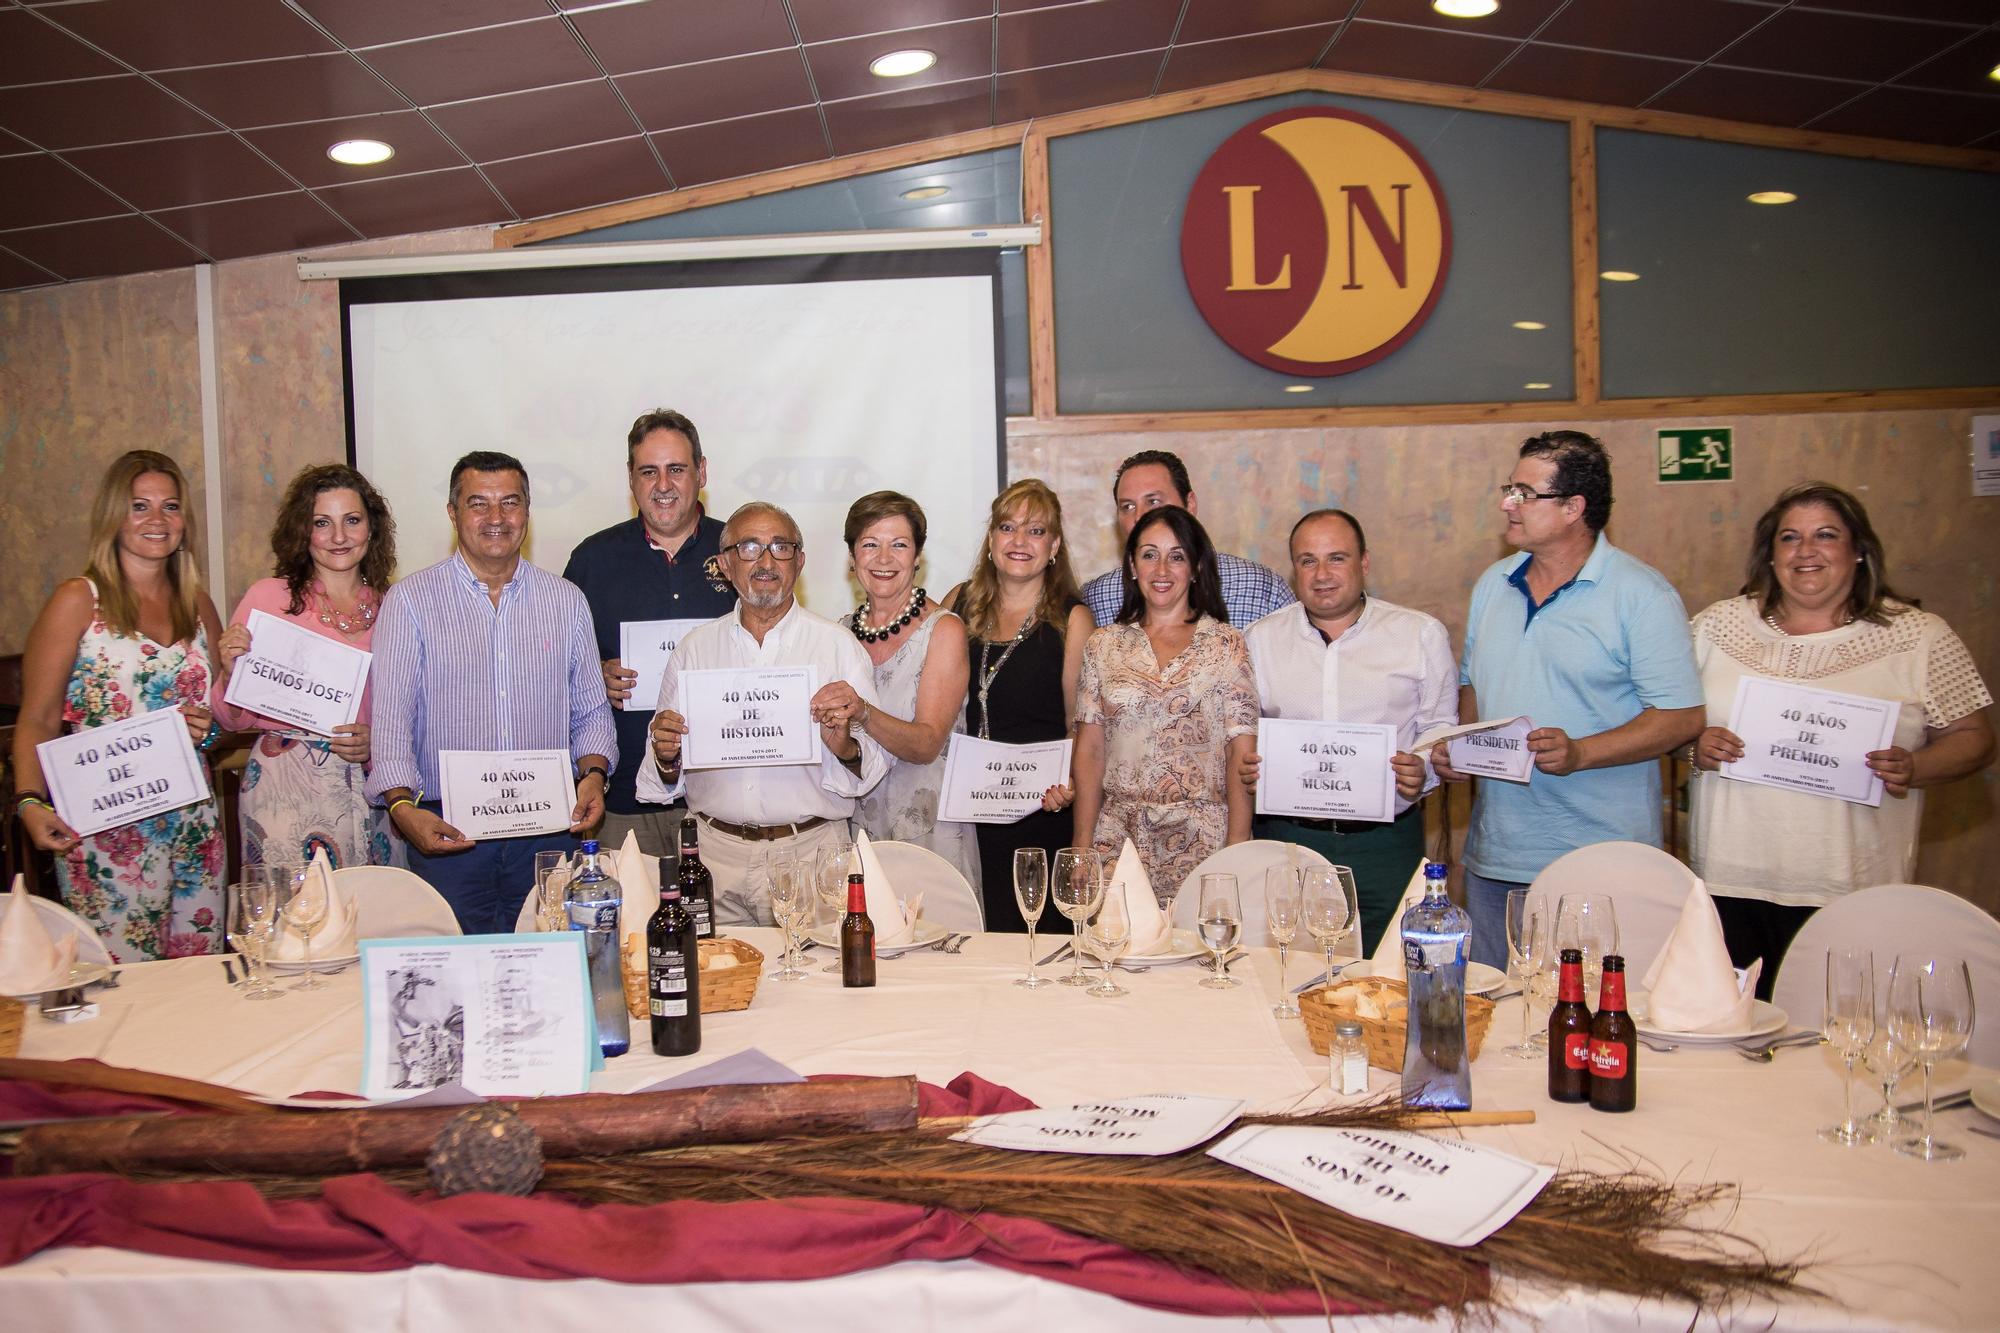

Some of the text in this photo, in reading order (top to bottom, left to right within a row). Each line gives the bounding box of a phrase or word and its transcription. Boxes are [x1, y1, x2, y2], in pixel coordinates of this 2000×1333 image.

[659, 640, 675, 651] 40
[722, 688, 780, 703] 40 AÑOS
[742, 708, 761, 720] DE
[1781, 709, 1848, 731] 40 AÑOS
[721, 726, 784, 739] HISTORIA
[1798, 730, 1821, 746] DE
[1300, 742, 1357, 756] 40 AÑOS
[1465, 734, 1520, 751] PRESIDENTE
[74, 733, 153, 767] 40 AÑOS
[1770, 744, 1840, 769] PREMIOS
[108, 763, 135, 783] DE
[985, 760, 1038, 772] 40 AÑOS
[1319, 761, 1337, 773] DE
[480, 769, 535, 783] 40 AÑOS
[1001, 777, 1017, 786] DE
[92, 778, 169, 813] AMISTAD
[501, 787, 520, 799] DE
[970, 791, 1045, 800] MONUMENTOS
[472, 801, 551, 816] PASACALLES
[1591, 1052, 1620, 1066] Estrella
